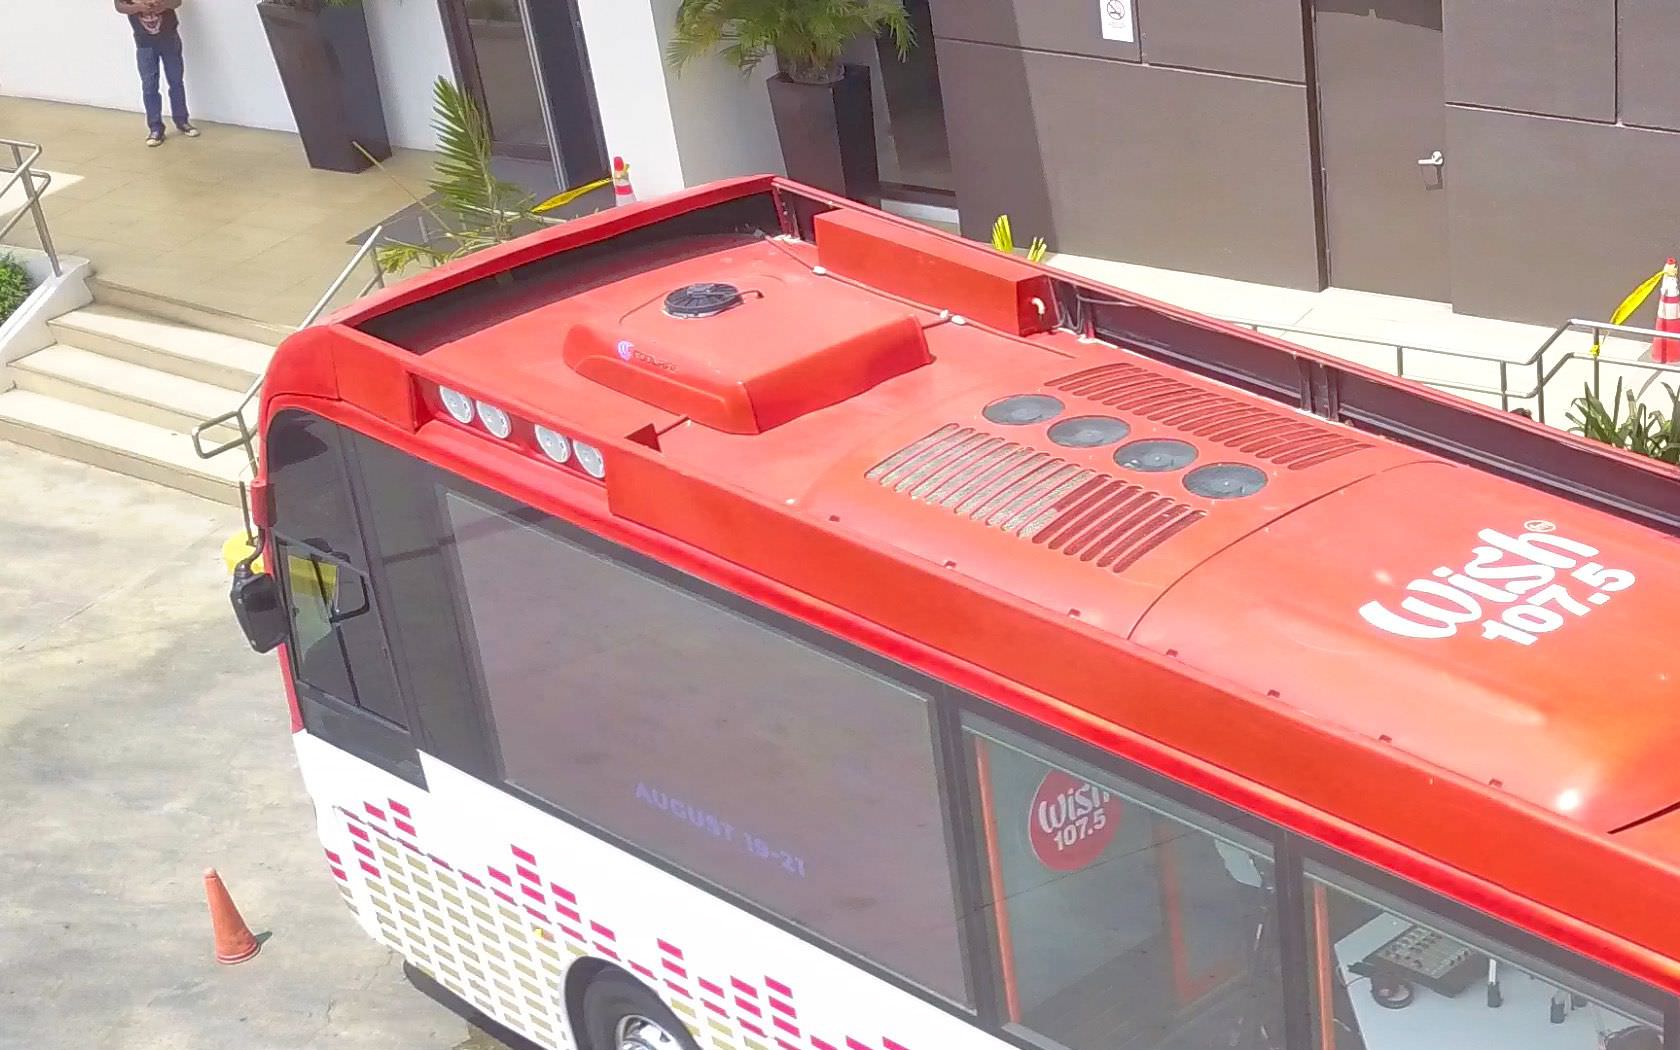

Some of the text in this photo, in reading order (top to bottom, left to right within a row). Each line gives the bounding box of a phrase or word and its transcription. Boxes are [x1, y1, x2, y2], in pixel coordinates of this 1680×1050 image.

[1481, 562, 1636, 646] 107.5
[635, 782, 736, 841] AUGUST
[1053, 808, 1106, 851] 107.5
